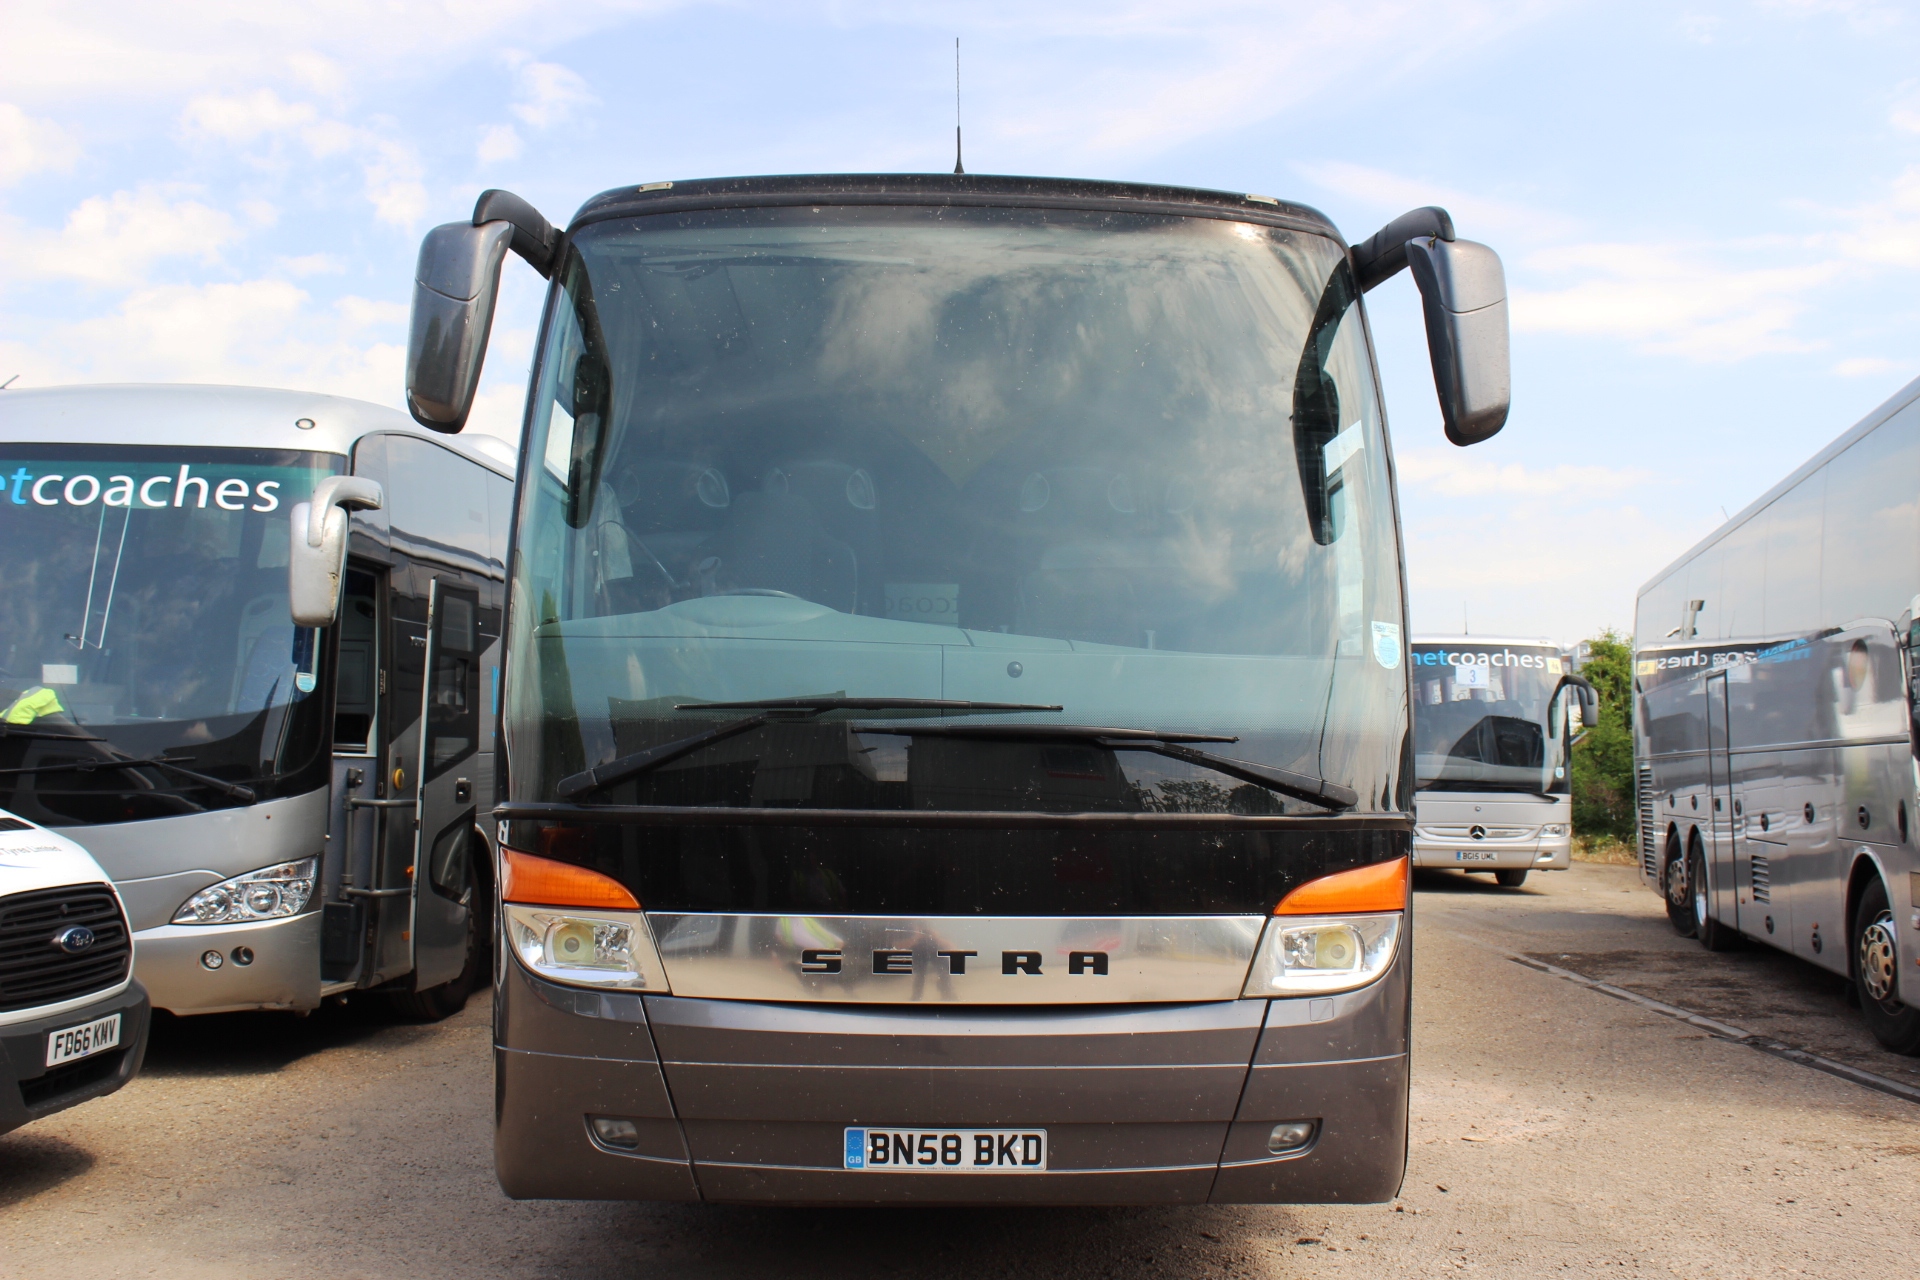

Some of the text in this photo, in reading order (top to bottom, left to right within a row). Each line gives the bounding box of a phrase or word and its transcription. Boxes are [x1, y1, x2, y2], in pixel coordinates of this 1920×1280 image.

[1469, 669, 1476, 683] 3
[801, 950, 1109, 975] SETRA
[54, 1026, 91, 1060] FD66
[848, 1133, 1042, 1166] GB BN58 BKD
